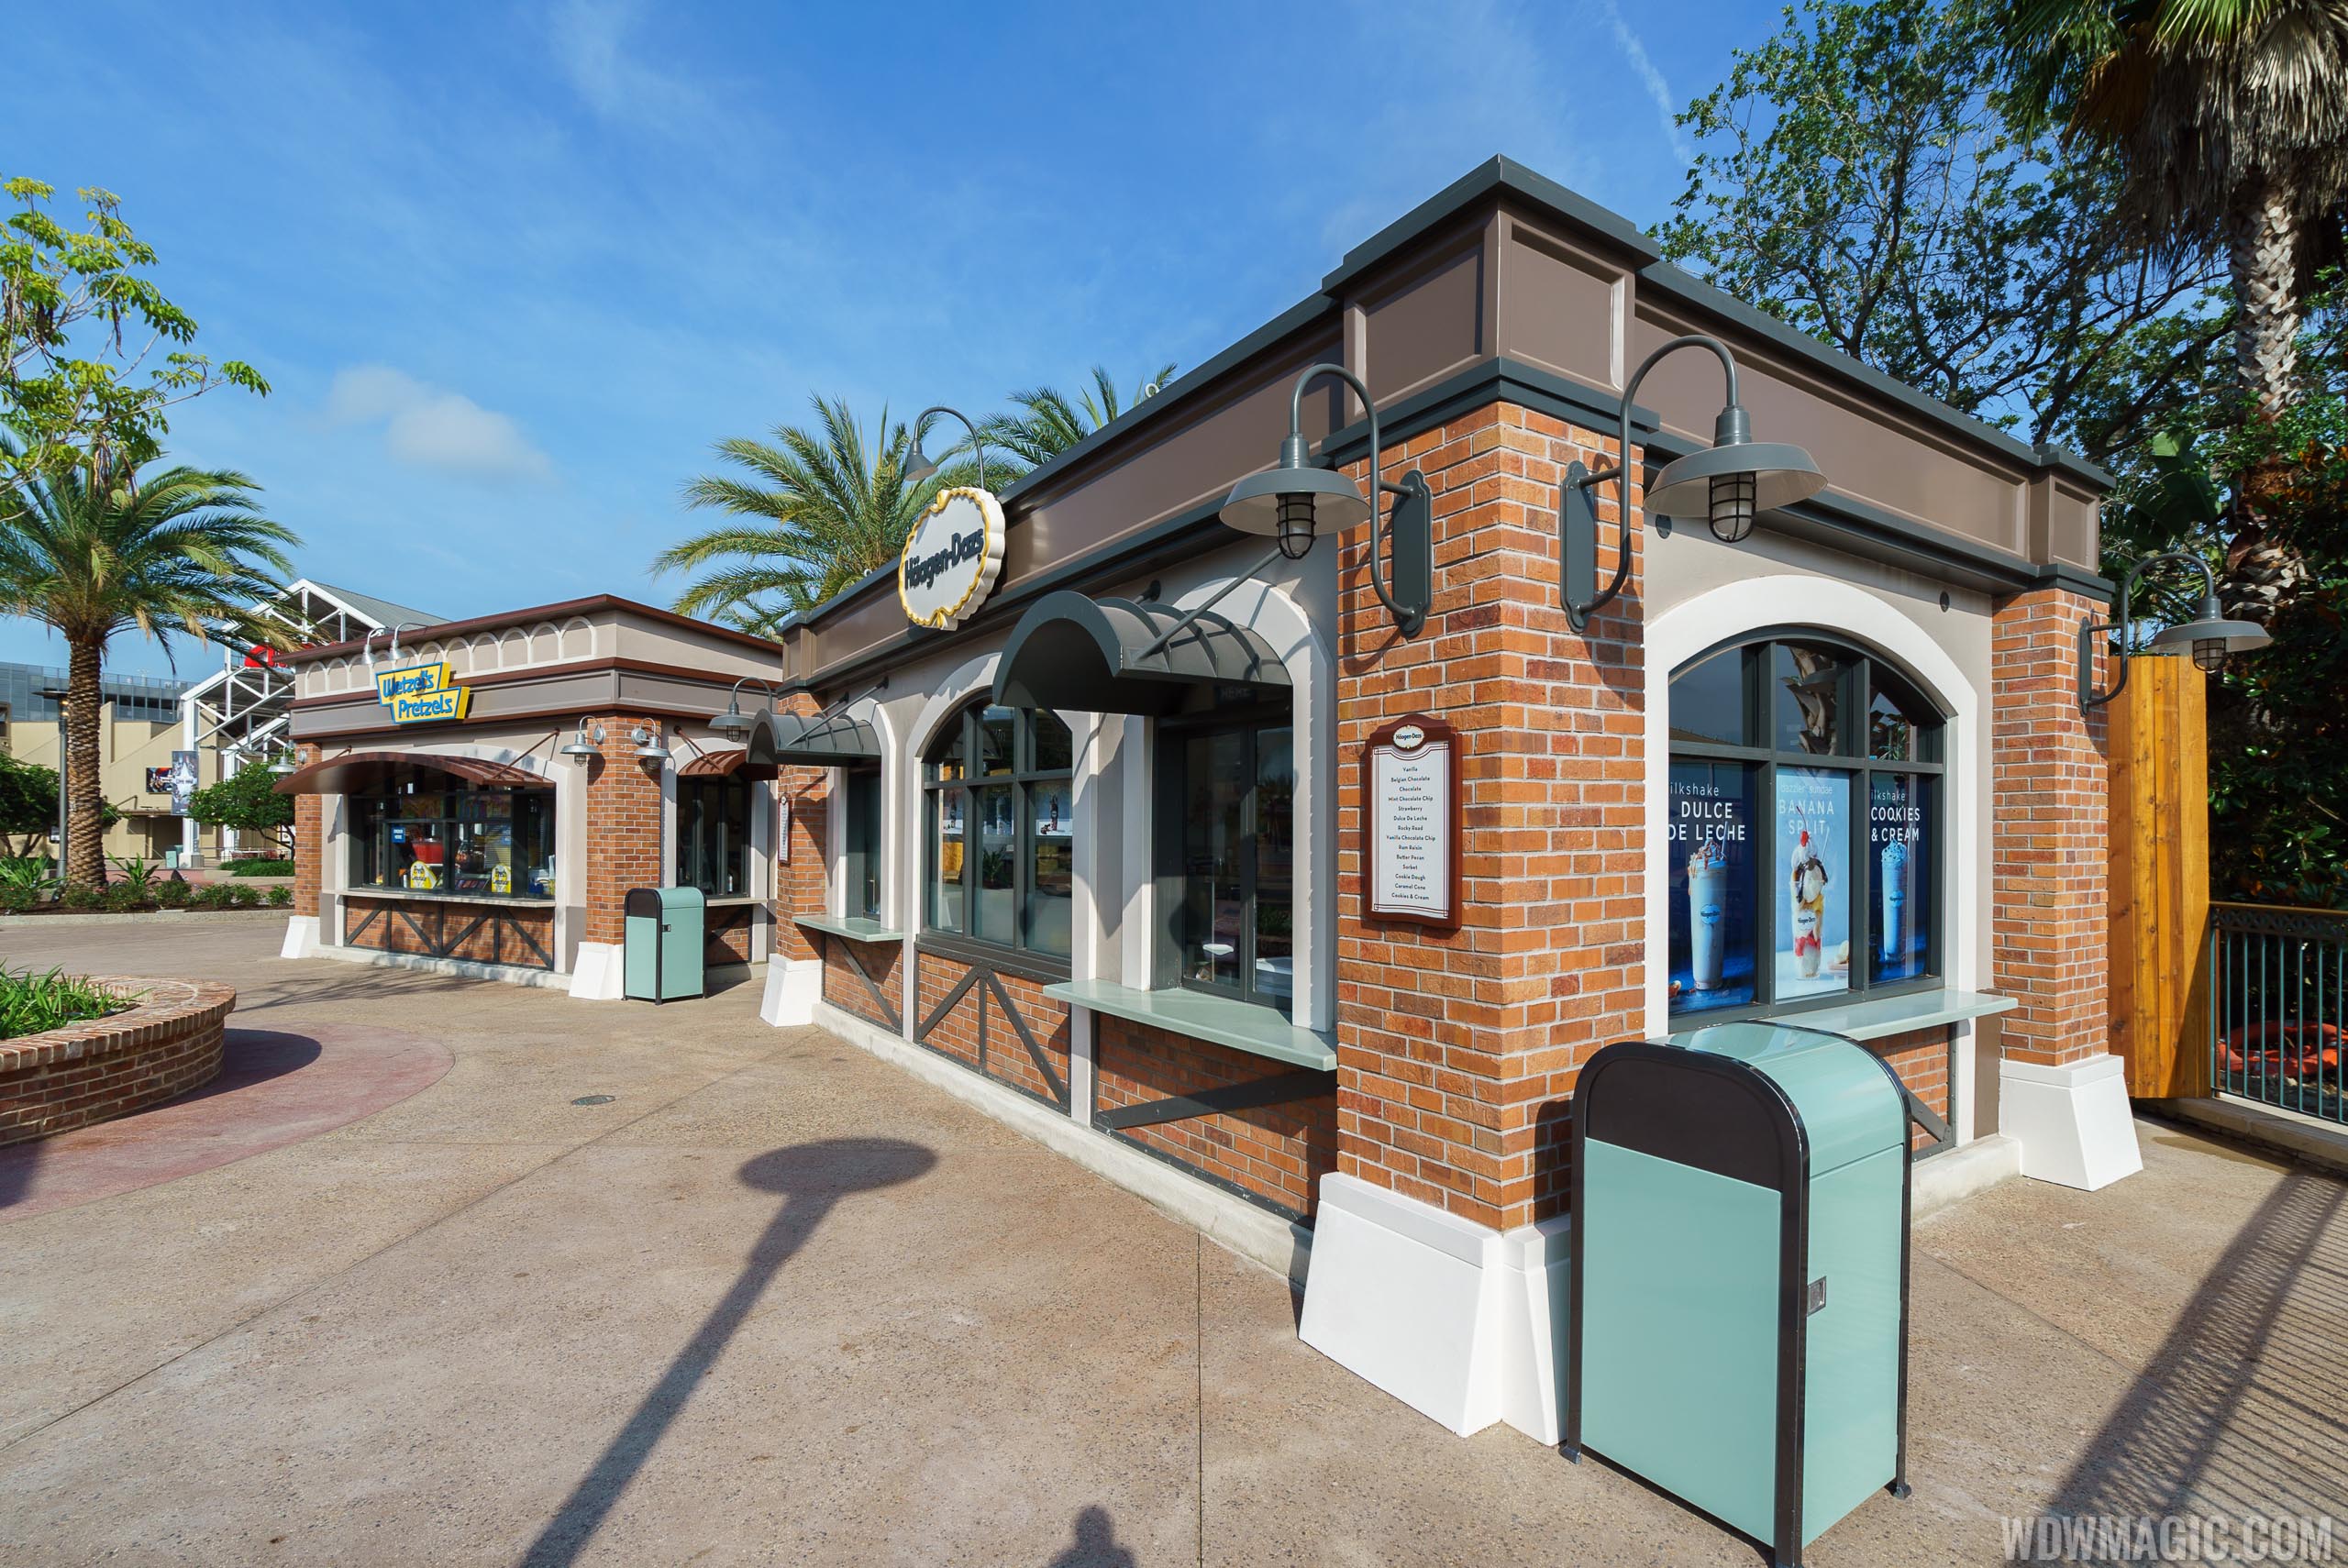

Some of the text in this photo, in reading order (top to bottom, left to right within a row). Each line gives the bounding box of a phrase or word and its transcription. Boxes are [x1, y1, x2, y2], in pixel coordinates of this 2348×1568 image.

[904, 528, 984, 591] Häagen-Dazs
[382, 669, 434, 699] Wetzel's
[398, 694, 453, 719] Pretzels
[1669, 782, 1720, 796] ilkshake
[1871, 789, 1906, 801] ilkshake
[1681, 801, 1733, 819] DULCE
[1778, 799, 1834, 815] BANANA
[1871, 806, 1921, 822] COOKIES
[1668, 823, 1745, 841] DE LECHE
[1789, 820, 1826, 835] SPLIT
[1871, 827, 1920, 842] & CREAM
